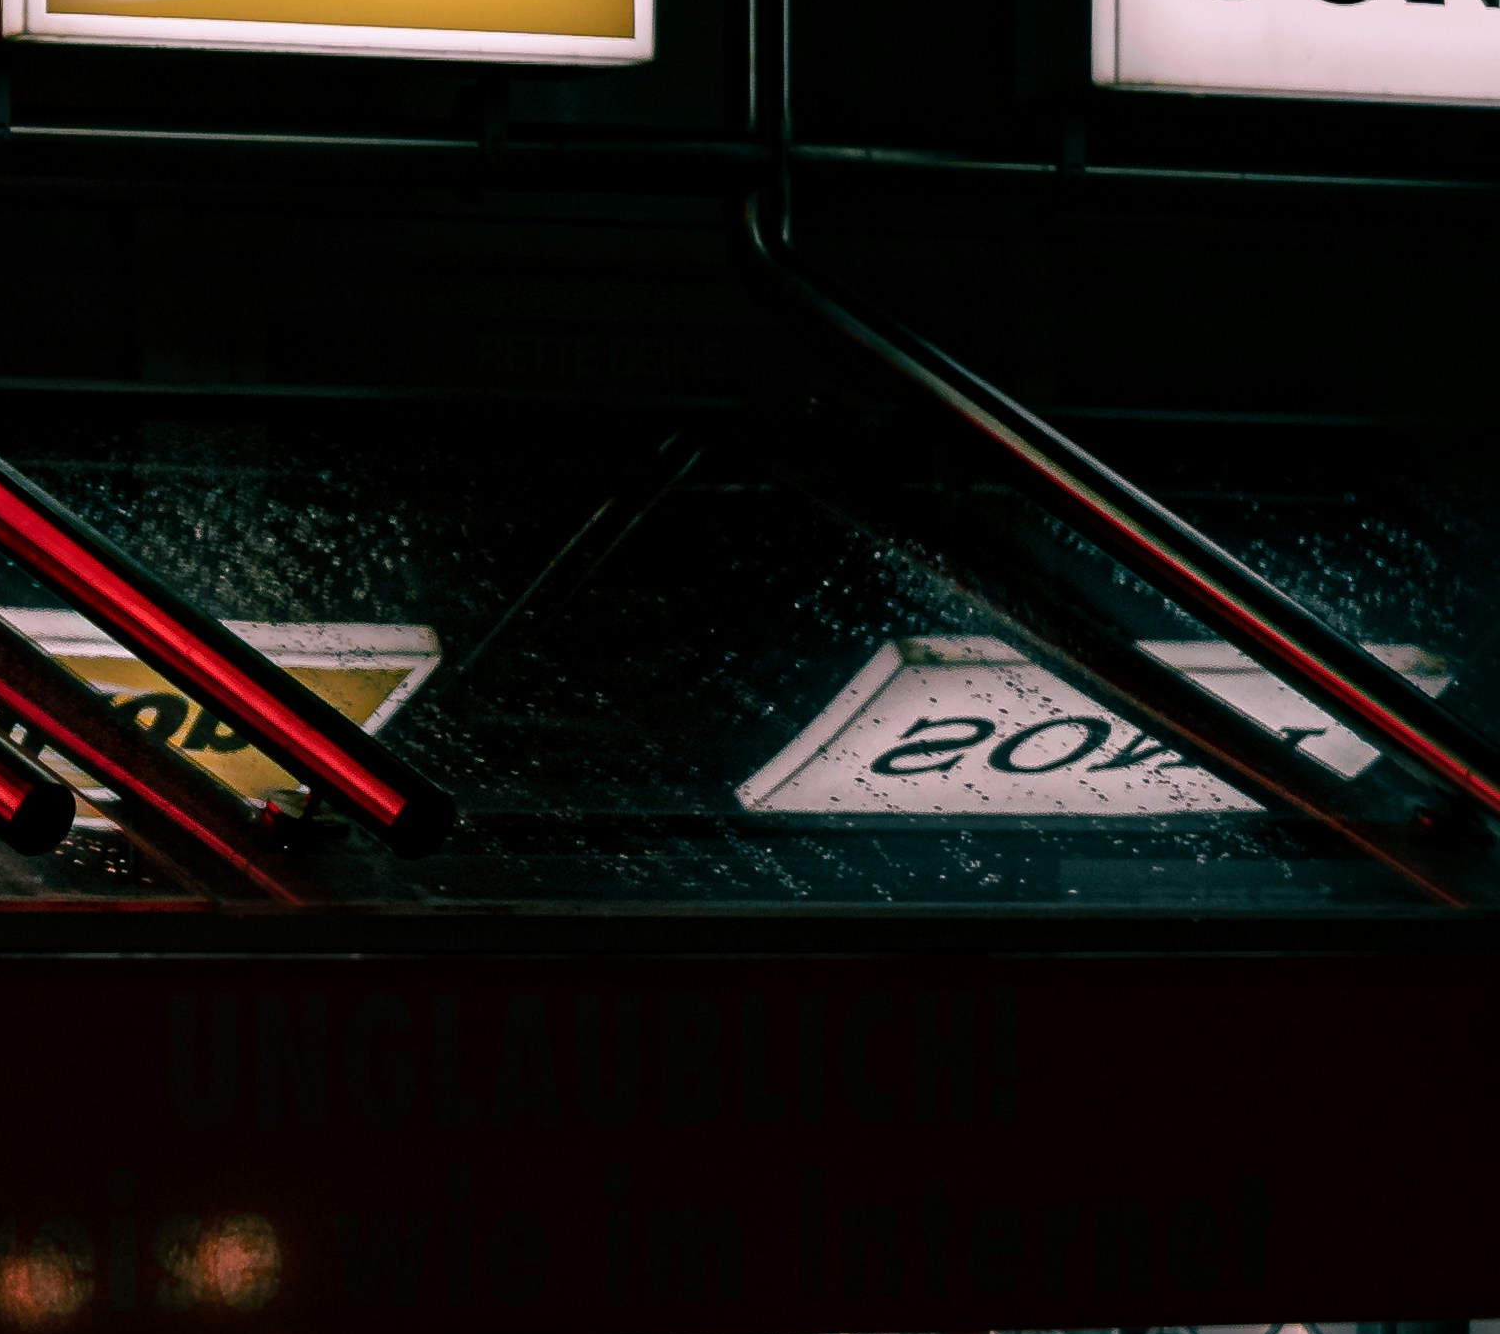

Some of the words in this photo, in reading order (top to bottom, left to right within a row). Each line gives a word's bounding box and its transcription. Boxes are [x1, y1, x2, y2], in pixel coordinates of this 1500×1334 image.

[166, 985, 1020, 1134] UNGLAUBLICH!
[335, 1162, 552, 1307] wie
[602, 1160, 744, 1305] im
[799, 1163, 1274, 1300] Internet
